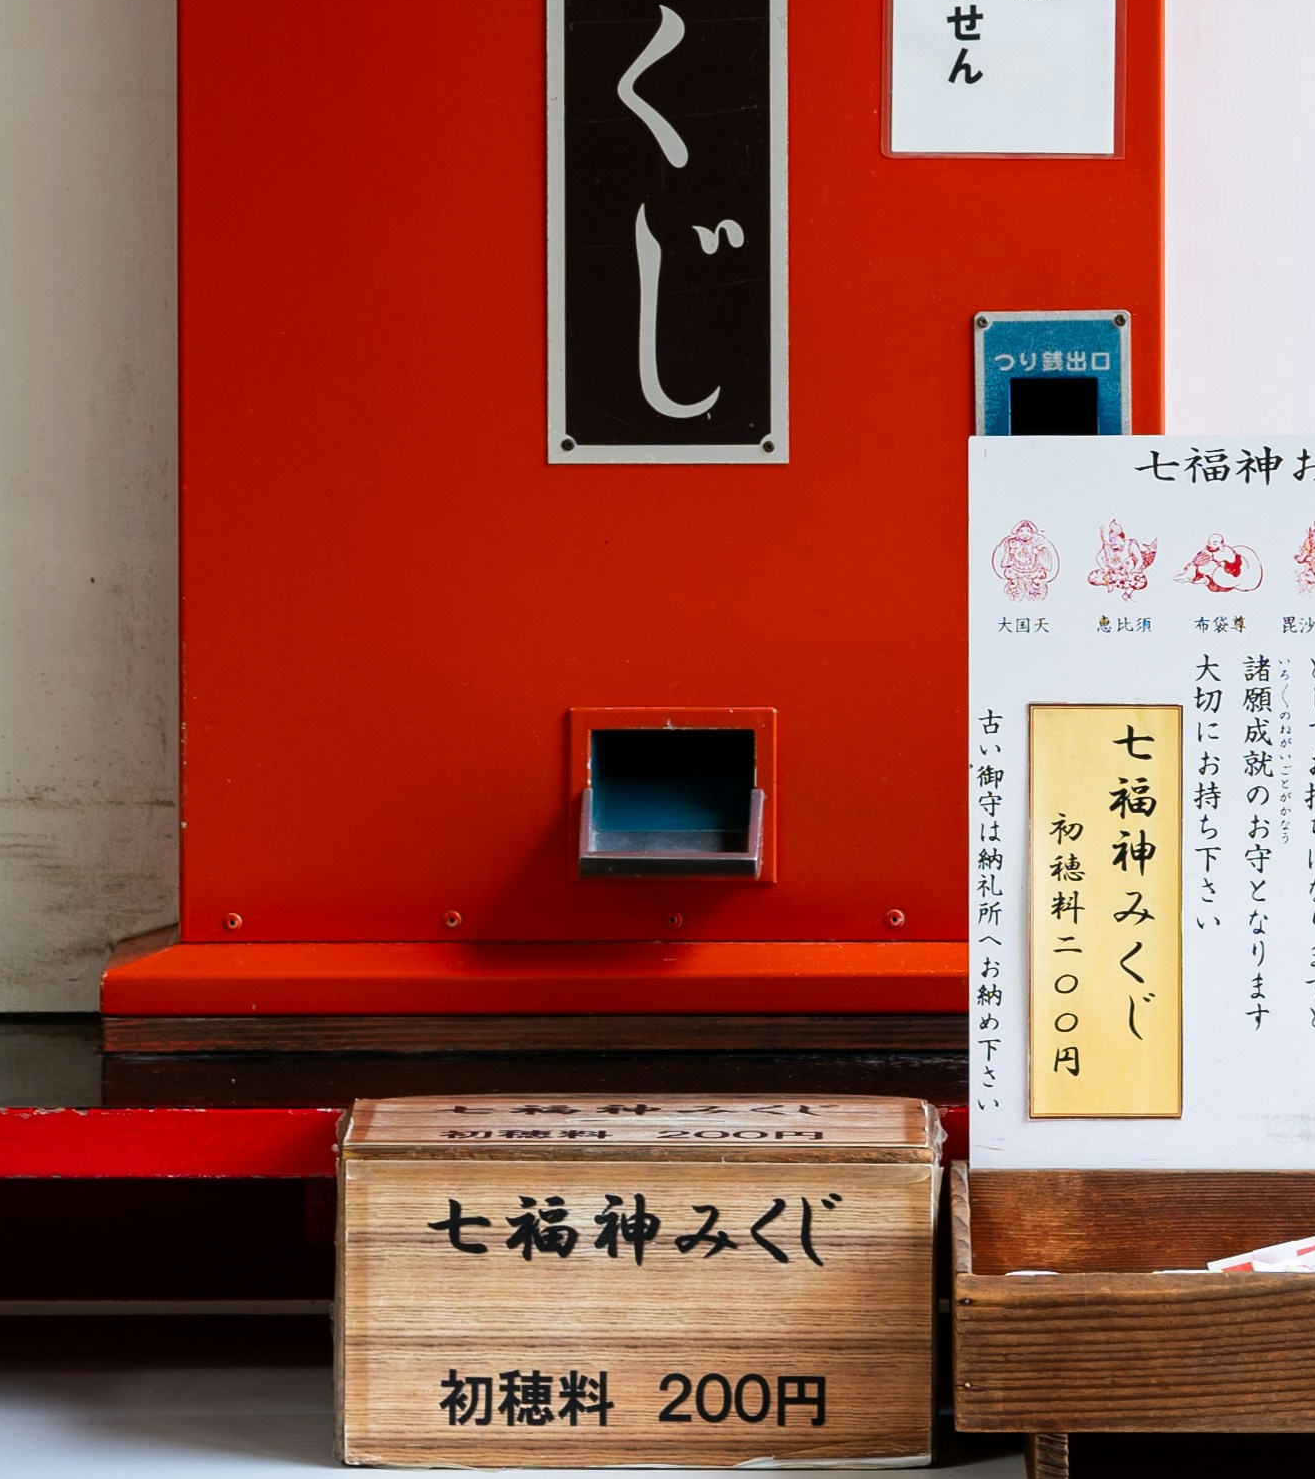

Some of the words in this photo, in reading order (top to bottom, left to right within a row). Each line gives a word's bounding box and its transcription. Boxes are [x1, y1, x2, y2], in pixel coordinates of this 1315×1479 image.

[994, 350, 1111, 372] つり銭出口
[998, 616, 1049, 634] 大国天
[1096, 614, 1152, 634] 恵比須
[1195, 615, 1246, 634] 布袋尊
[1193, 653, 1223, 930] 大切にお持ち下さい
[1242, 654, 1274, 1030] 諸願成就のお守となります
[1108, 724, 1157, 1041] 七福神みくじ
[441, 1102, 841, 1118] 七福神みくじ
[439, 1129, 613, 1141] 初穂料
[657, 1129, 825, 1141] 200円
[427, 1193, 844, 1267] 七福神みくじ
[439, 1368, 615, 1427] 初穂料
[658, 1372, 827, 1428] 200円
